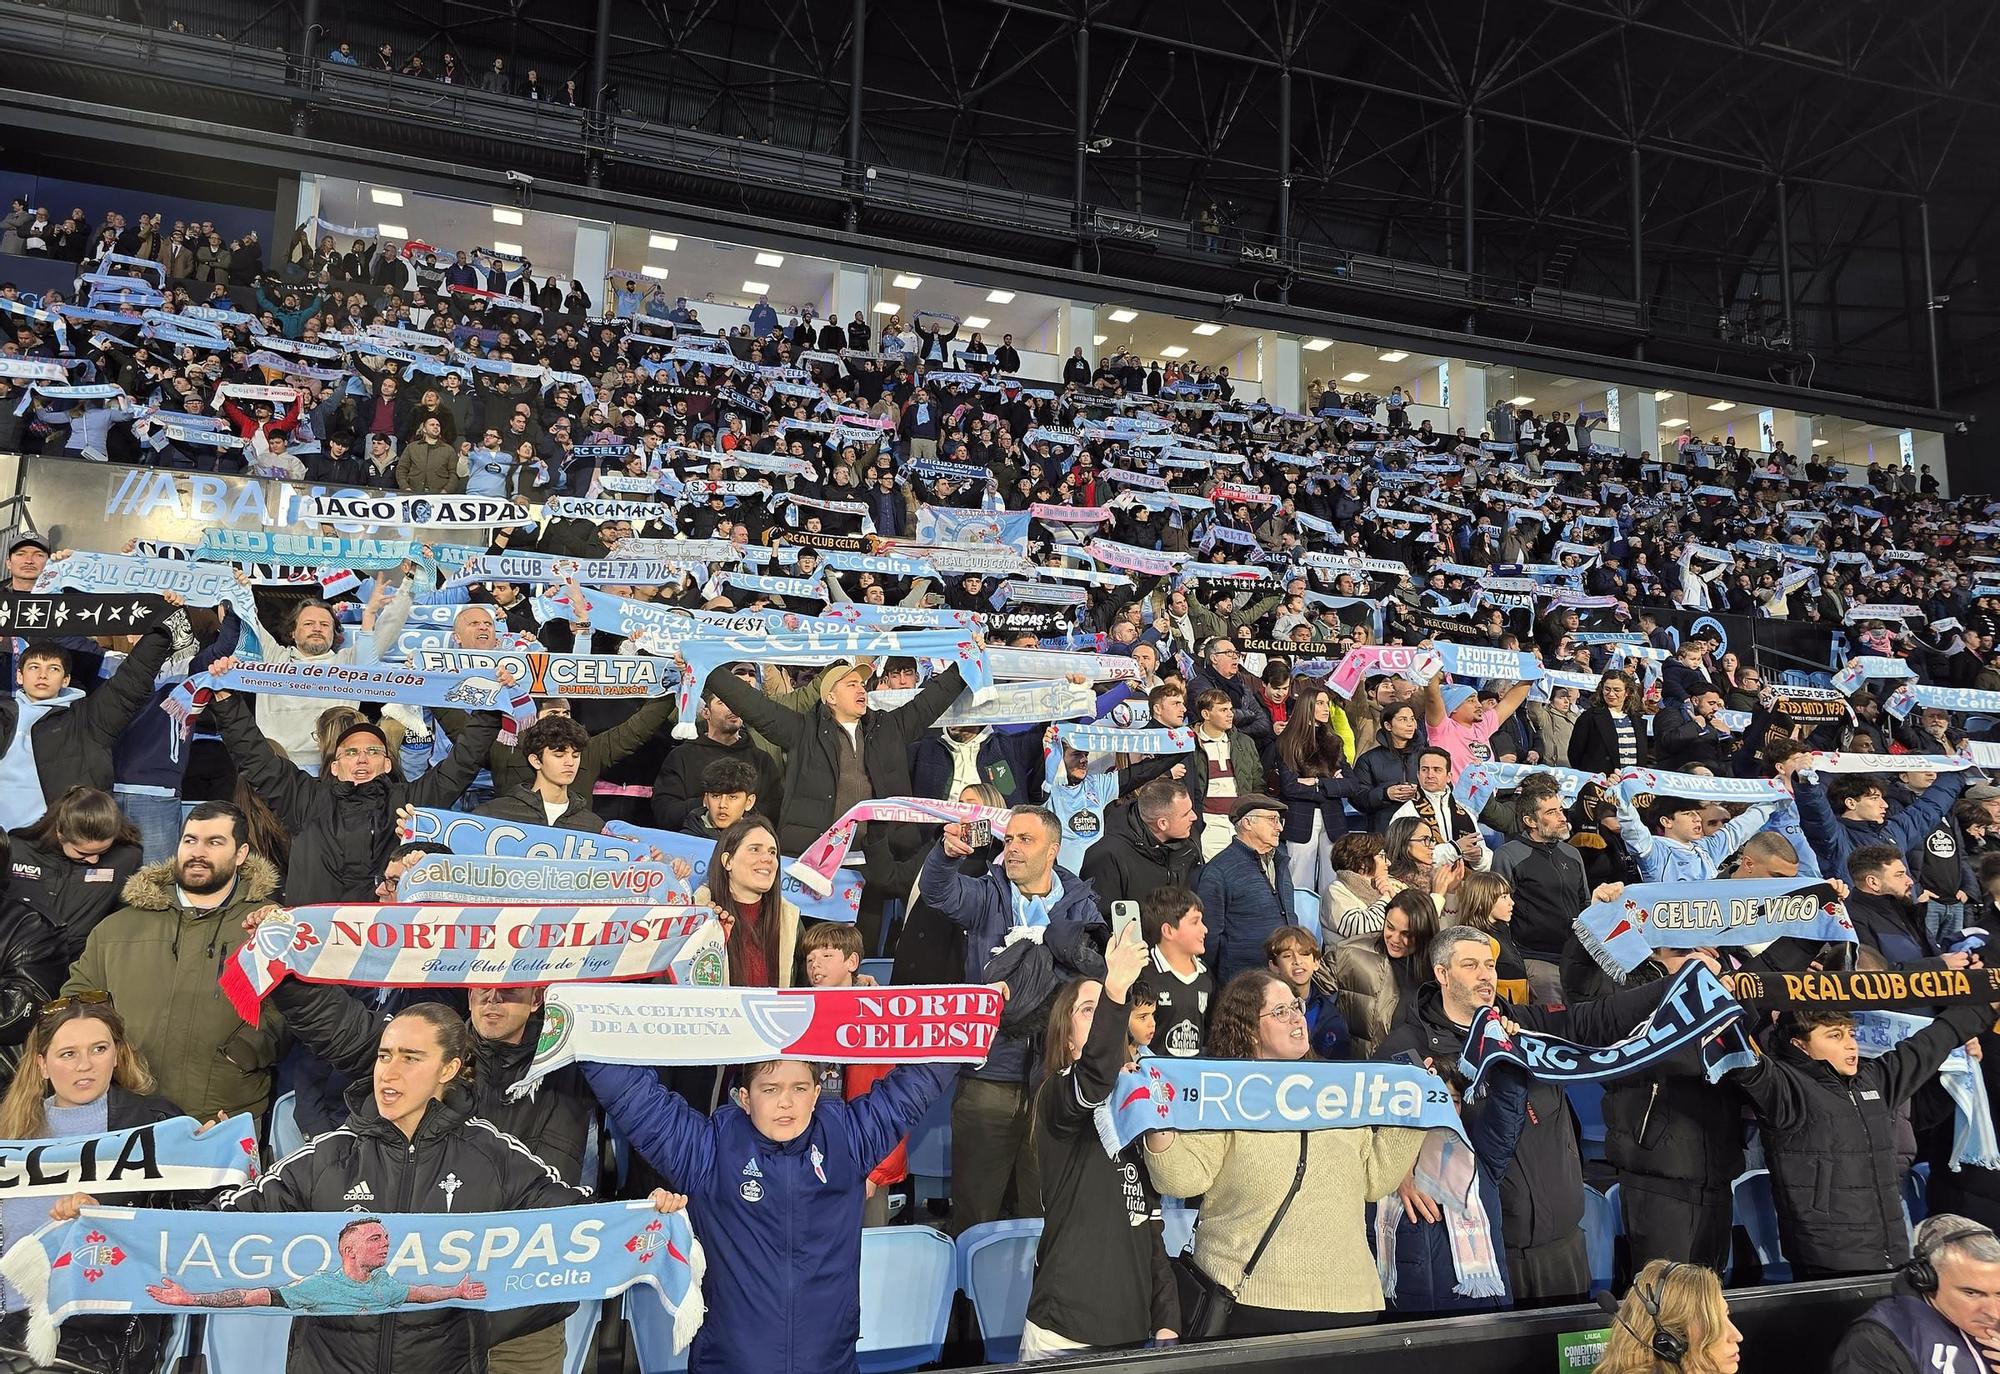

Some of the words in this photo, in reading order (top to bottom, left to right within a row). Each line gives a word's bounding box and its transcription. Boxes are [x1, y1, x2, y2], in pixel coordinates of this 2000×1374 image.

[574, 445, 590, 456] RC
[592, 445, 630, 456] CELTA
[316, 496, 396, 520] IAGO
[436, 500, 529, 522] ASPAS
[787, 532, 810, 546] REAL
[811, 535, 833, 548] CLUB
[835, 537, 861, 550] CELTA
[752, 549, 791, 561] SEMRE
[836, 552, 912, 574] RCCelta
[938, 555, 962, 567] REAL
[963, 556, 990, 569] CLUB
[991, 558, 1019, 570] CELTA
[57, 559, 118, 586] REAL
[123, 565, 192, 592] CLUB
[501, 558, 541, 576] CLUB
[588, 561, 638, 579] CELTA
[730, 571, 813, 597] RCCelta
[1005, 614, 1044, 627] ASPAS
[1458, 624, 1478, 635] CELTA
[1244, 638, 1271, 650] REAL
[1272, 640, 1296, 652] CLUB
[1298, 642, 1328, 654] CELTA
[1456, 646, 1520, 665] AFOUTEZA
[233, 661, 298, 675] uadrilla
[302, 665, 322, 678] de
[327, 667, 369, 683] Pepa
[372, 674, 382, 682] a
[385, 672, 425, 686] Loba
[550, 659, 657, 684] CELTA
[1110, 668, 1136, 679] 1923
[1456, 662, 1464, 675] E
[240, 676, 283, 689] Tenemos
[318, 684, 331, 692] en
[332, 684, 354, 694] todo
[364, 687, 396, 697] mundo
[558, 685, 600, 696] DUNHA
[1663, 773, 1716, 791] SEMPRE
[1721, 777, 1764, 793] CELTA
[12, 863, 42, 876] NASA
[404, 860, 665, 894] ealclubceltadevigo
[1651, 897, 1725, 931] CELTA
[1730, 898, 1760, 926] DE
[1764, 894, 1818, 923] VIGO
[331, 919, 496, 950] NORTE
[422, 957, 467, 974] Real
[470, 956, 506, 973] Club
[512, 956, 550, 972] Celta
[552, 955, 573, 971] de
[1785, 971, 1848, 1002] REAL
[1849, 972, 1907, 1001] CLUB
[1909, 969, 1971, 998] CELTA
[576, 1001, 631, 1018] PEÑA
[635, 1003, 743, 1019] CELTISTA
[857, 993, 998, 1019] NORTE
[590, 1020, 621, 1035] DE
[623, 1021, 640, 1036] A
[643, 1020, 732, 1036] CORUÑA
[1519, 1034, 1579, 1072] RC
[1182, 1086, 1199, 1102] 19
[1198, 1071, 1423, 1122] RCCelta
[1426, 1089, 1449, 1104] 23
[344, 1191, 375, 1201] adidas
[159, 1230, 332, 1284] IAGO
[386, 1219, 606, 1277] ASPAS
[504, 1269, 592, 1292] RCCelta
[1569, 1356, 1581, 1368] PIE
